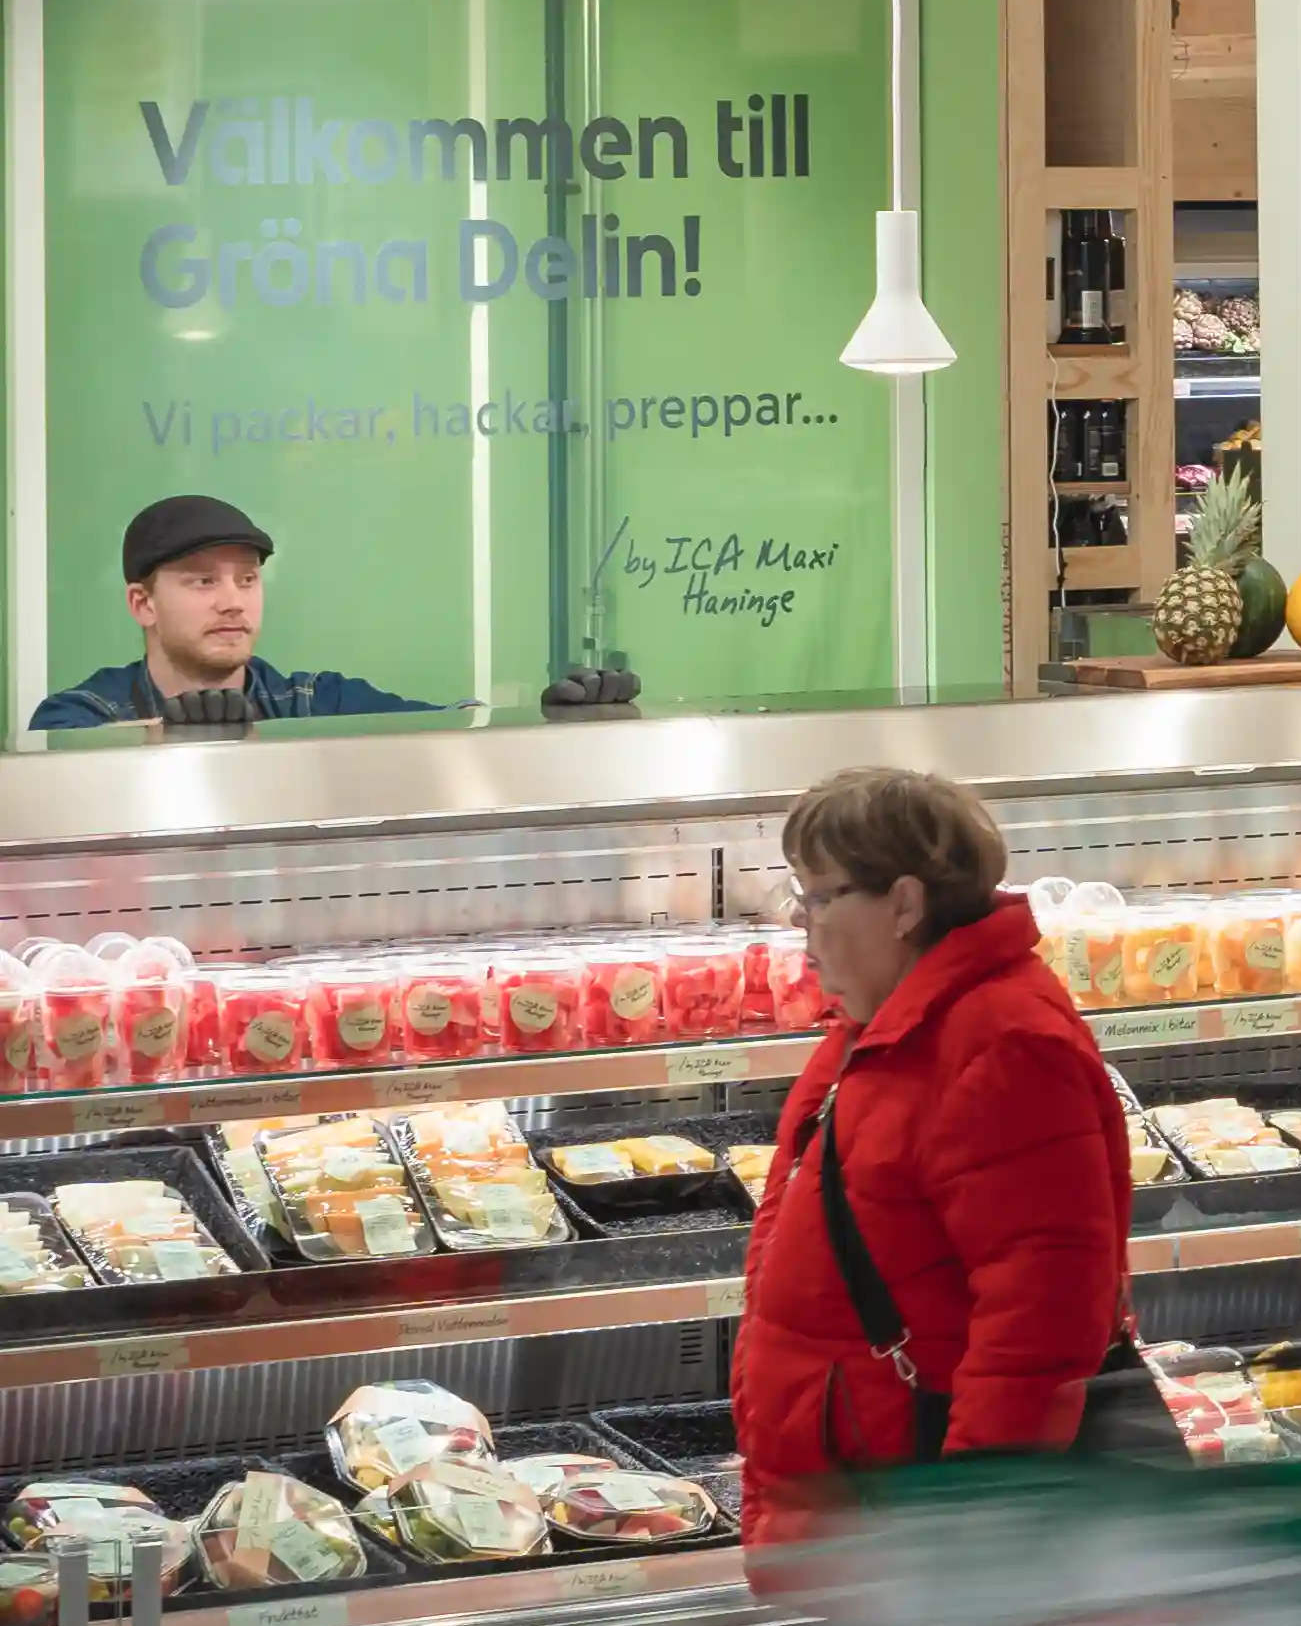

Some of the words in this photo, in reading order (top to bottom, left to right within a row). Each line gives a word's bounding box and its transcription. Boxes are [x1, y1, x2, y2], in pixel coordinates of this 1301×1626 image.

[139, 96, 688, 186] Välkommen
[716, 93, 811, 179] till
[140, 218, 429, 310] Gröna
[459, 213, 702, 302] Delin!
[141, 400, 191, 446] Vi
[210, 395, 396, 456] packar,
[412, 387, 590, 441] hackar,
[606, 387, 839, 442] preppar...
[665, 534, 745, 574] ICA
[756, 538, 840, 571] Maxi
[683, 572, 795, 628] Haninge
